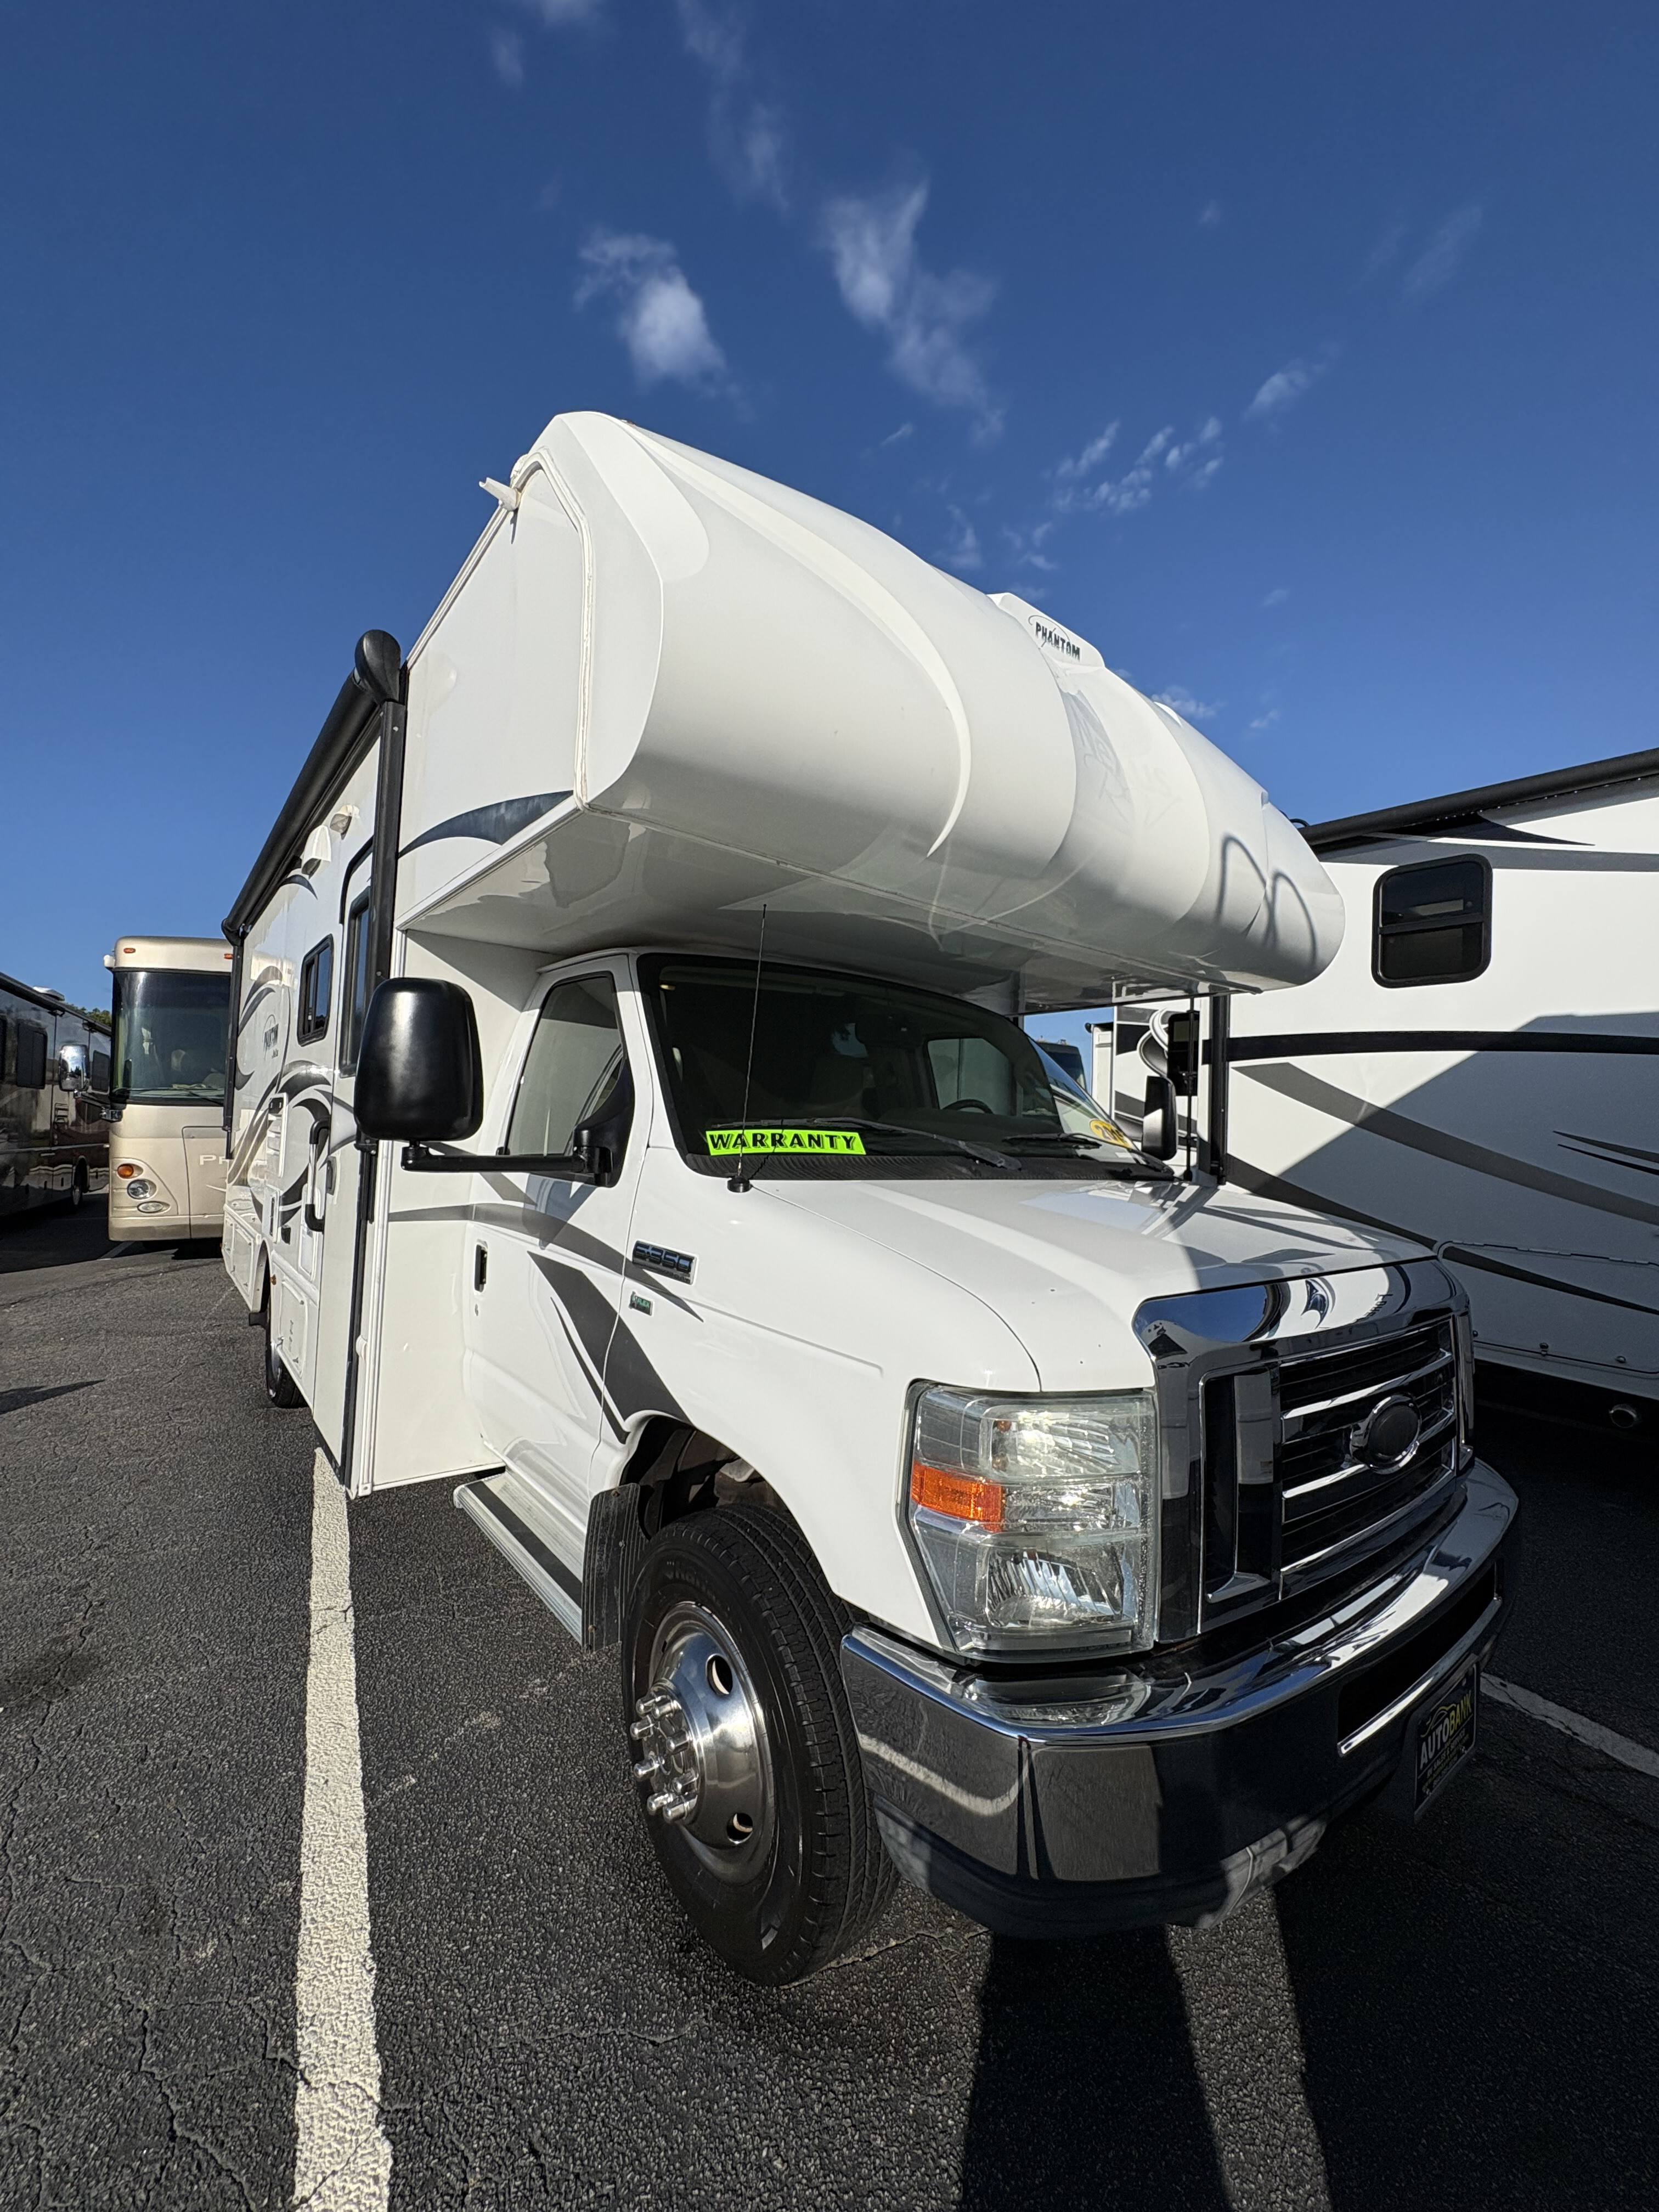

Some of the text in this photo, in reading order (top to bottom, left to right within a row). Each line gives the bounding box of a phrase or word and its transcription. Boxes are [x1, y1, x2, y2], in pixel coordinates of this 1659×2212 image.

[1035, 621, 1081, 662] PHANTOM
[709, 1133, 856, 1151] WARRANTY
[1420, 1689, 1472, 1770] AUTOBANK
